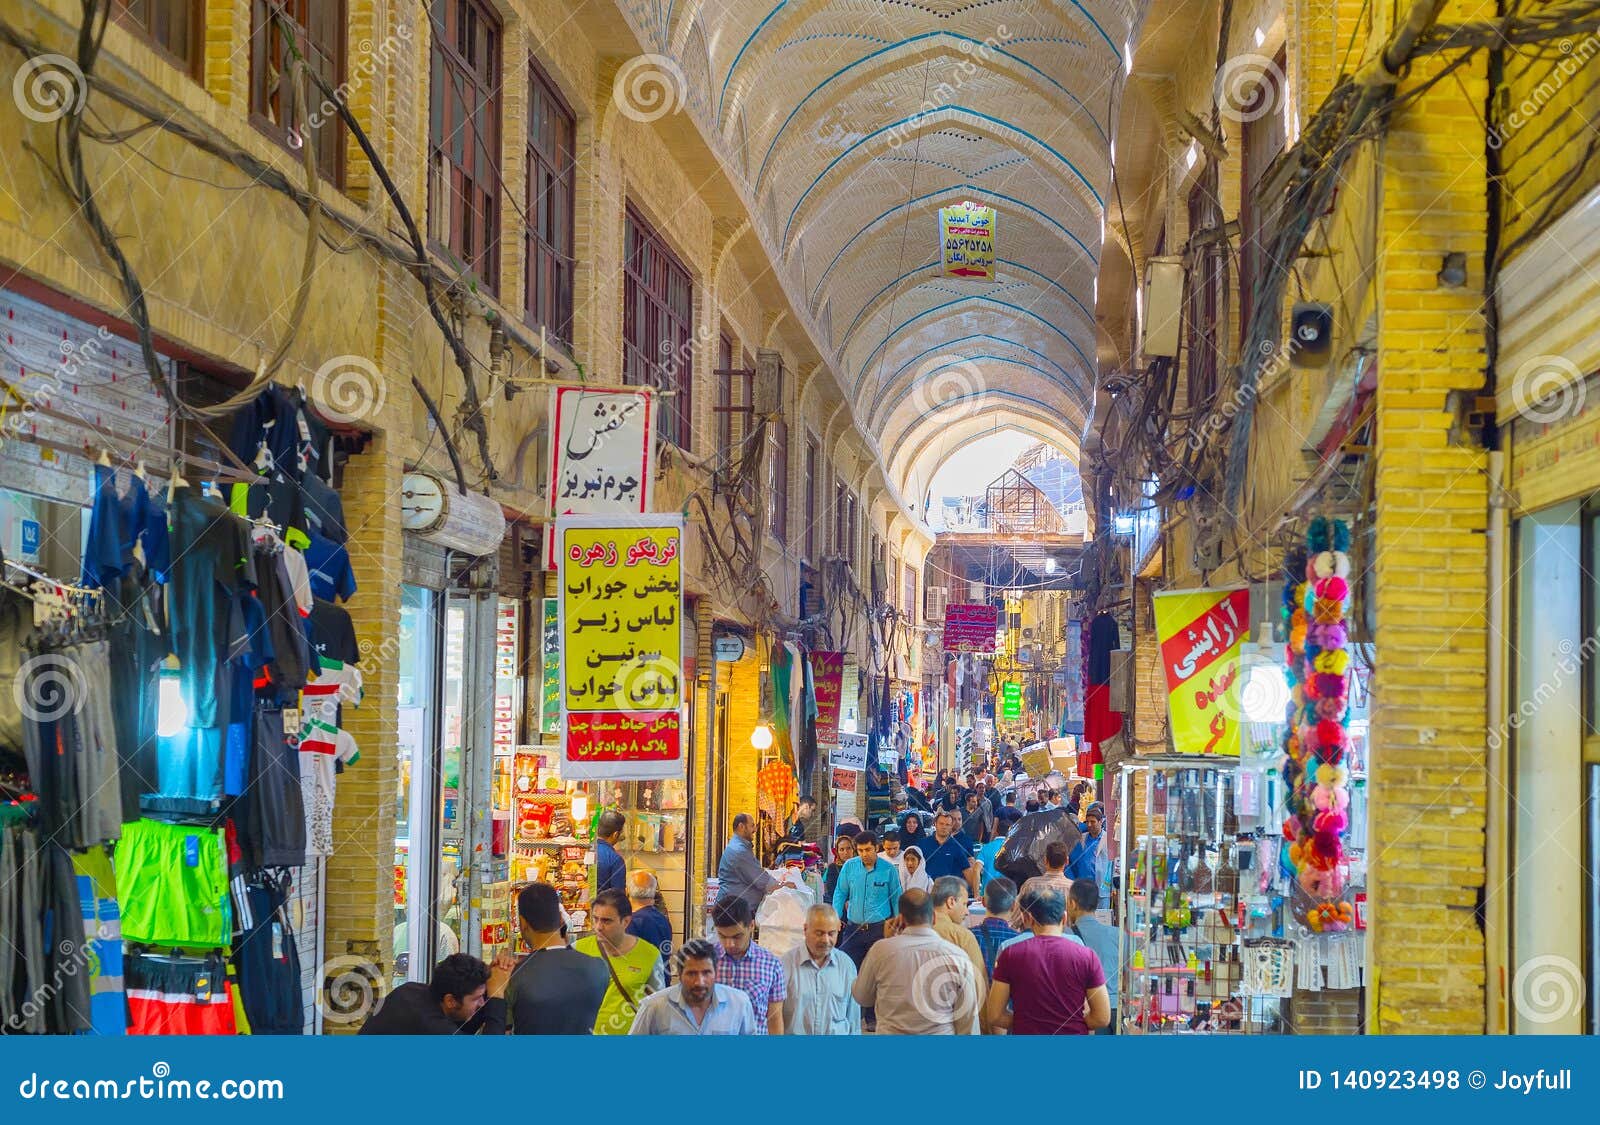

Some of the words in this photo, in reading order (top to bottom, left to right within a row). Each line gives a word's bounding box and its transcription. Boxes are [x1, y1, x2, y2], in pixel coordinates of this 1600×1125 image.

[948, 214, 969, 225] آمدید
[972, 216, 989, 227] خوش
[947, 252, 970, 265] رایگان
[566, 401, 640, 461] کفش
[561, 468, 602, 499] تبریز
[603, 474, 639, 502] چرم
[569, 542, 618, 567] زهره
[625, 537, 678, 567] تریکو
[567, 575, 628, 600] جوراب
[633, 574, 680, 600] پخش
[571, 609, 620, 634] زیر
[626, 605, 676, 633] لباس
[1173, 598, 1240, 680] آرایشی
[586, 641, 662, 669] سوتین
[569, 675, 623, 702] خواب
[630, 675, 679, 703] لباس
[569, 720, 589, 735] چپ
[591, 719, 617, 732] سمت
[619, 717, 647, 732] حیاط
[649, 717, 679, 733] داخل
[629, 740, 639, 752] ۸
[641, 740, 668, 756] پلاک
